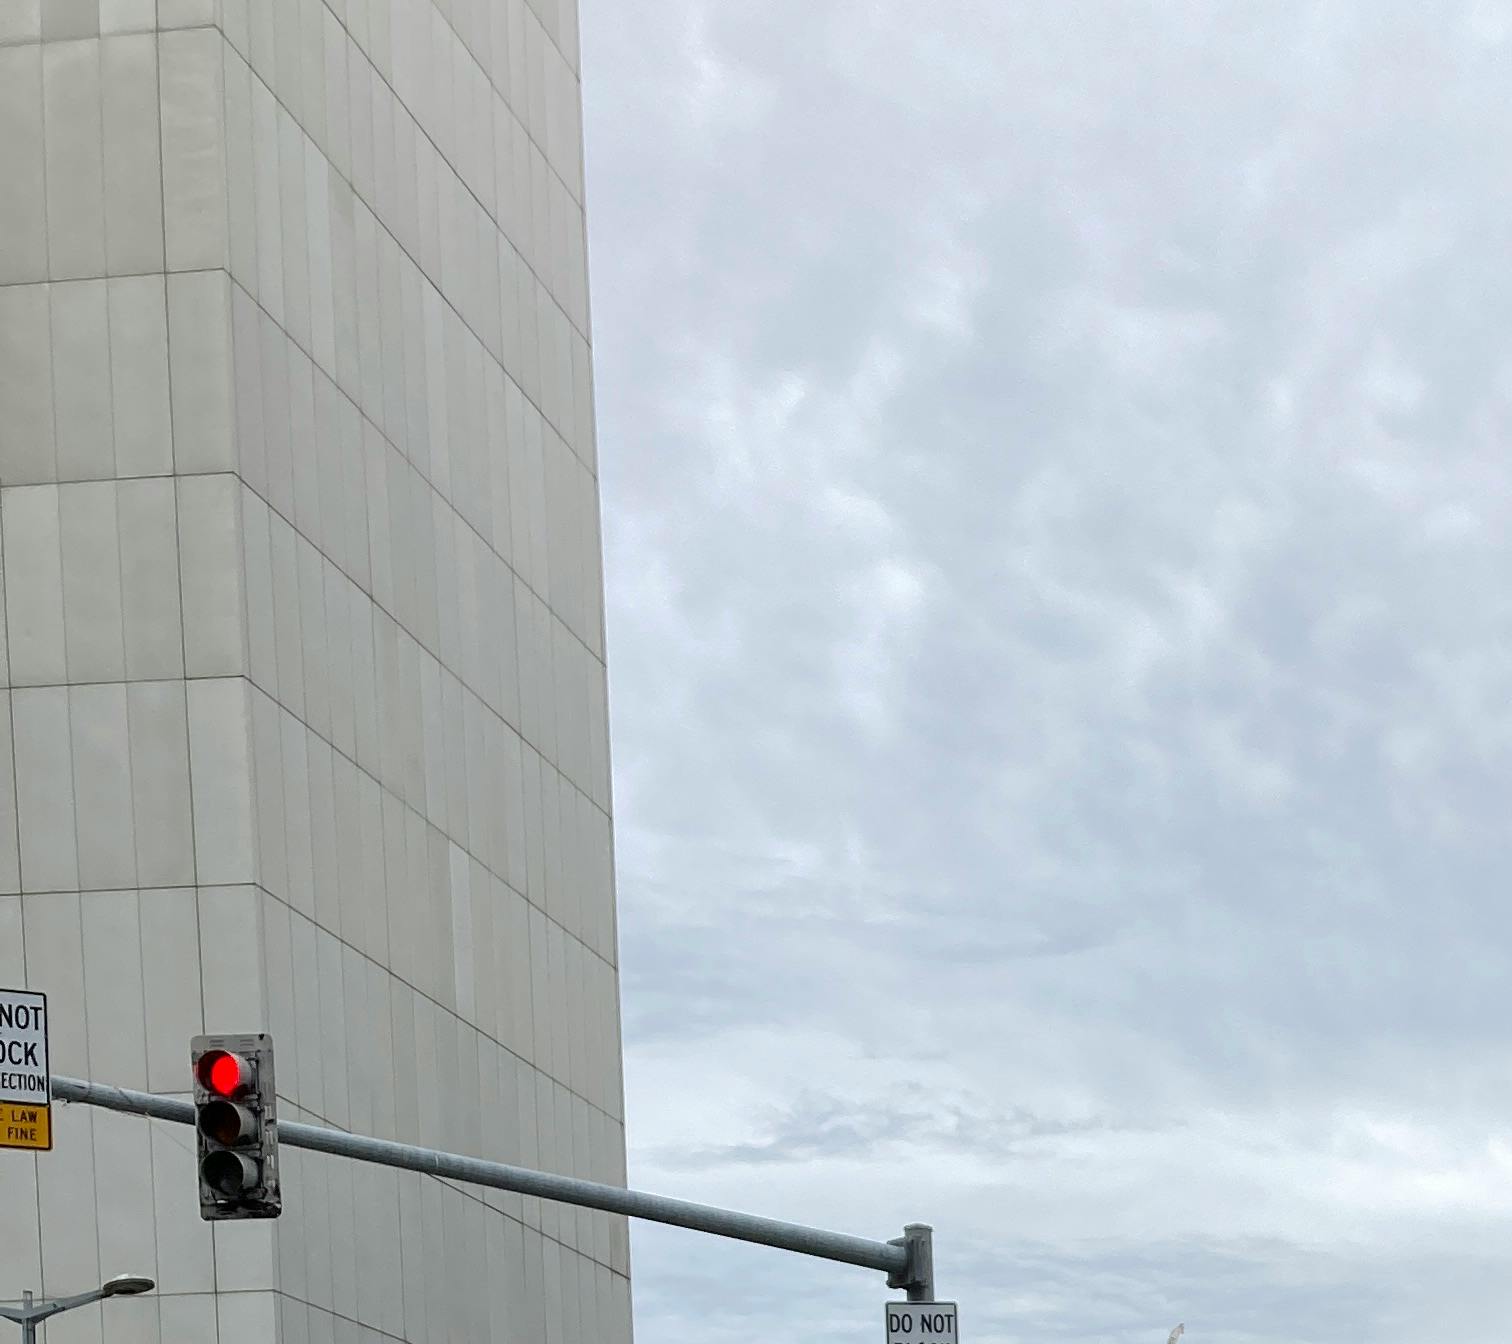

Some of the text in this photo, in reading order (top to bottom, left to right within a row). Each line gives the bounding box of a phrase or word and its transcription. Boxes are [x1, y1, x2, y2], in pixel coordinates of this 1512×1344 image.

[11, 1109, 38, 1123] LAW
[7, 1126, 37, 1141] FINE
[889, 1313, 954, 1333] DO NOT
